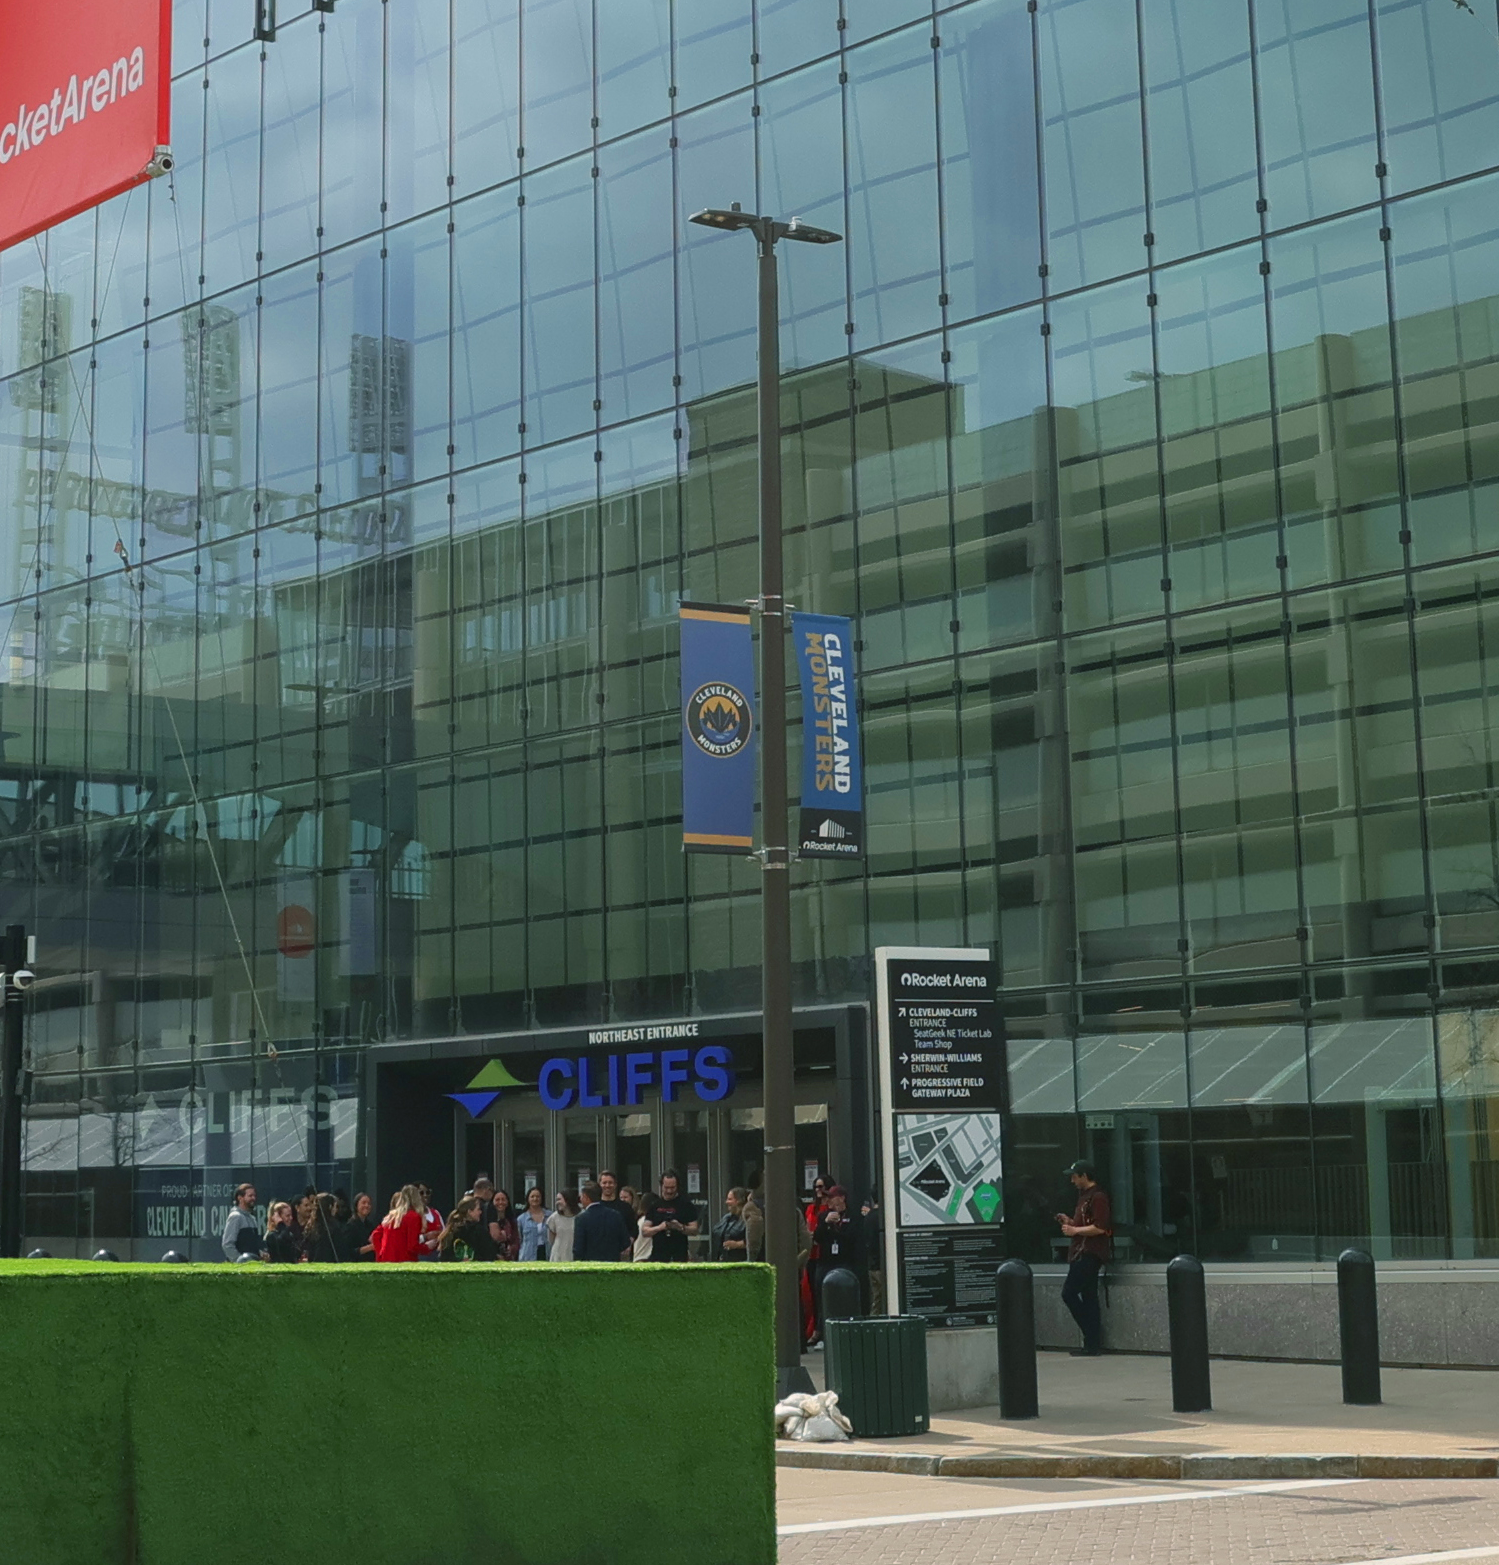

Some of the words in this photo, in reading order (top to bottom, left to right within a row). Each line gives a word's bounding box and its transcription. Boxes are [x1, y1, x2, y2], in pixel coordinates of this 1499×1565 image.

[695, 685, 744, 708] CLEVELAND
[804, 631, 835, 792] MONSTERS
[824, 632, 851, 794] CLEVELAND
[696, 734, 743, 755] MONSTERS
[810, 840, 836, 852] Rocket
[836, 841, 858, 853] Arena
[912, 973, 951, 987] Rocket
[953, 974, 987, 987] Arena
[909, 1007, 978, 1017] CLEVELAND-CLIFFS
[909, 1018, 947, 1028] ENTRANCE
[588, 1026, 645, 1045] NORTHEAST
[647, 1023, 699, 1041] ENTRANCE
[957, 1029, 978, 1038] Ticket
[979, 1029, 992, 1038] Lab
[914, 1039, 933, 1048] Team
[934, 1039, 952, 1050] Shop
[911, 1053, 982, 1063] SHERWIN-WILLIAMS
[911, 1064, 949, 1073] ENTRANCE
[538, 1045, 734, 1111] CLIFFS
[911, 1077, 962, 1087] PROGRESSIVE
[963, 1077, 984, 1086] FIELD
[912, 1088, 946, 1098] GATEWAY
[947, 1088, 971, 1097] PLAZA
[179, 1085, 339, 1136] CLIFFS
[191, 1184, 223, 1198] ARTNER
[146, 1205, 206, 1237] CLEVELAND
